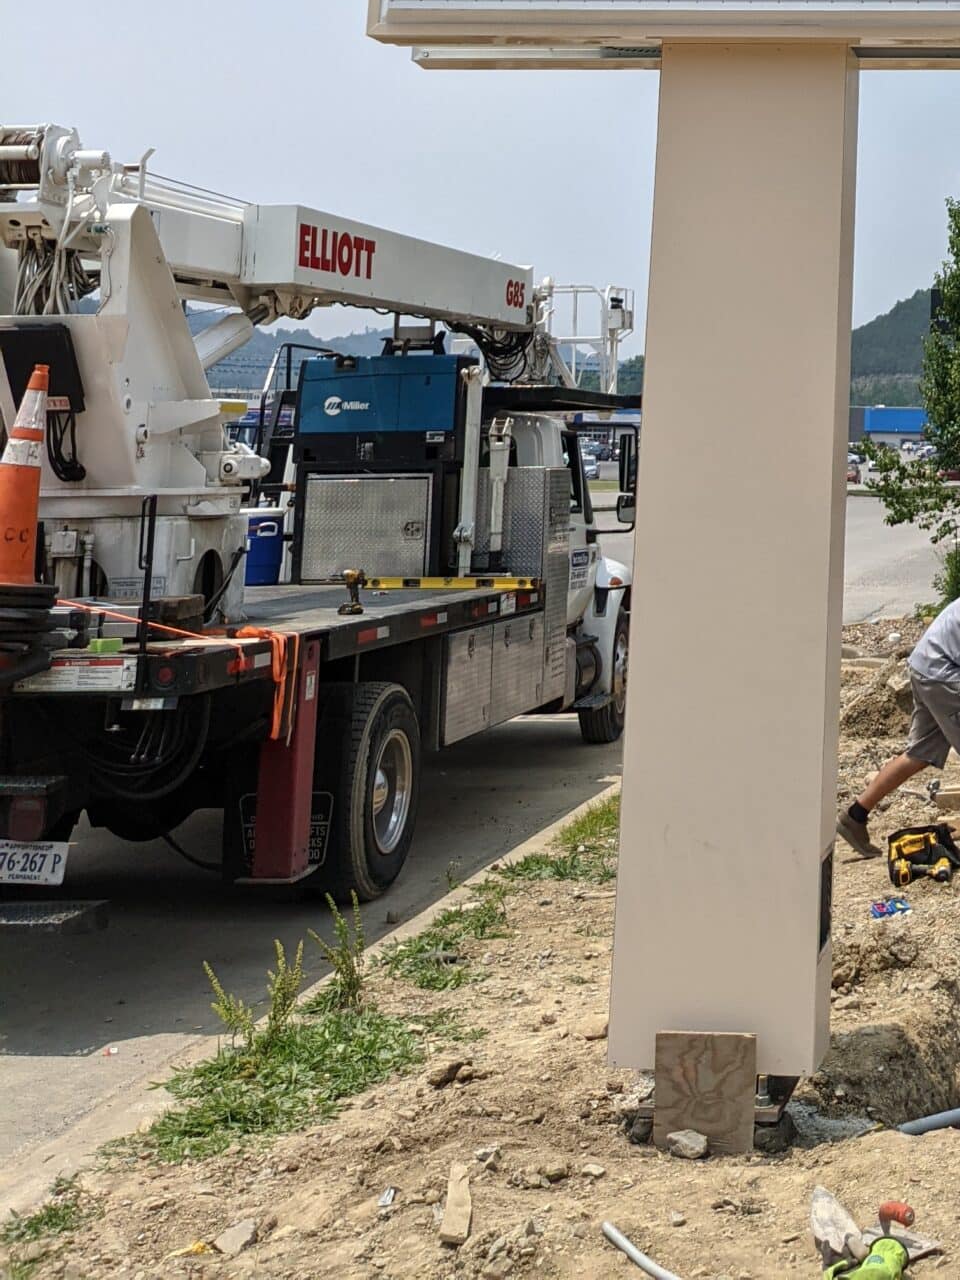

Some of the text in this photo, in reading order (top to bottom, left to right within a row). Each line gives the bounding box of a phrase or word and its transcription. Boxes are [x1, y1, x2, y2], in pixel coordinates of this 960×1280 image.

[298, 223, 376, 280] ELLIOTT
[506, 280, 525, 308] G85
[342, 401, 369, 410] Miller
[51, 853, 62, 873] P
